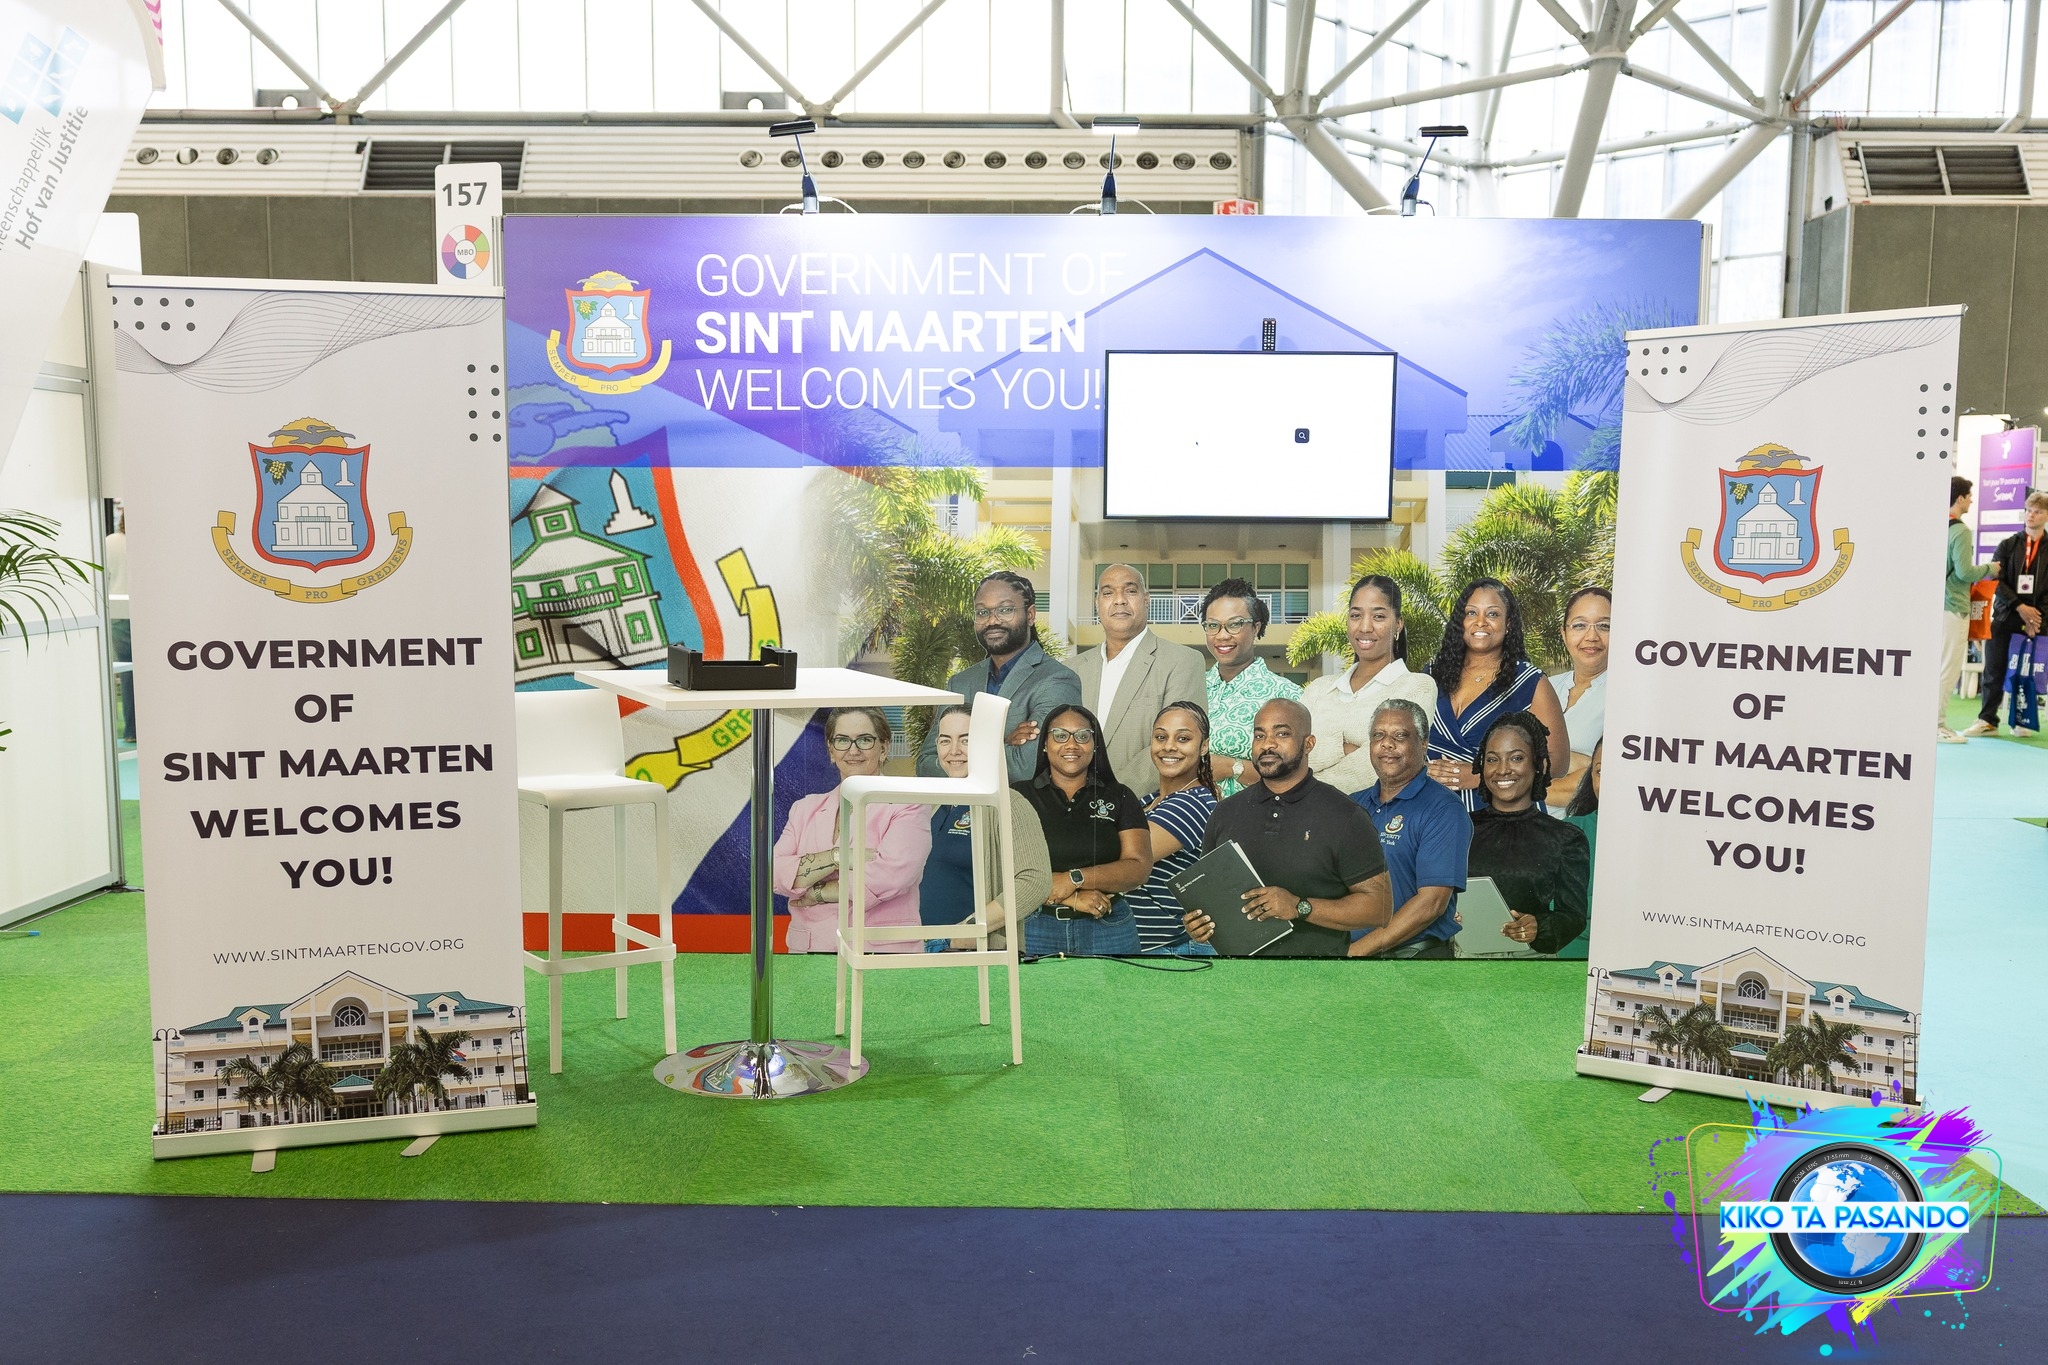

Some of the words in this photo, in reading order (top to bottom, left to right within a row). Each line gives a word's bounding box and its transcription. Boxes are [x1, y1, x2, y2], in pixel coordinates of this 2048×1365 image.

[0, 126, 52, 251] eenschappelijk
[15, 207, 43, 250] Hof
[35, 174, 59, 210] van
[49, 104, 89, 174] Justitie
[442, 182, 488, 207] 157
[457, 248, 475, 256] MBO
[696, 252, 1046, 298] GOVERNMENT
[1062, 251, 1128, 296] OF
[695, 310, 815, 355] SINT
[829, 310, 1086, 353] MAARTEN
[549, 349, 577, 382] SEMPER
[600, 384, 619, 392] PRO
[695, 367, 976, 411] WELCOMES
[990, 367, 1101, 411] YOU!
[222, 548, 268, 586] SEMPER
[305, 590, 329, 600] PRO
[356, 538, 408, 587] GREDIENS
[1687, 560, 1723, 594] SEMPER
[1752, 600, 1773, 608] PRO
[1799, 553, 1849, 597] GREDIENS
[167, 637, 483, 671] GOVERNMENT
[1635, 639, 1911, 677] GOVERNMENT
[294, 693, 354, 723] OF
[1732, 693, 1786, 721] OF
[163, 750, 265, 782] SINT
[279, 743, 493, 778] MAARTEN
[1621, 734, 1704, 765] SINT
[1714, 740, 1912, 781] MAARTEN
[190, 800, 461, 839] WELCOMES
[1637, 785, 1875, 831] WELCOMES
[280, 856, 393, 889] YOU!
[1706, 839, 1806, 875] YOU!
[1642, 911, 1866, 947] WWW.SINTMAARTENGOV.ORG
[213, 938, 464, 964] WWW.SINTMAARTENGOV.ORG
